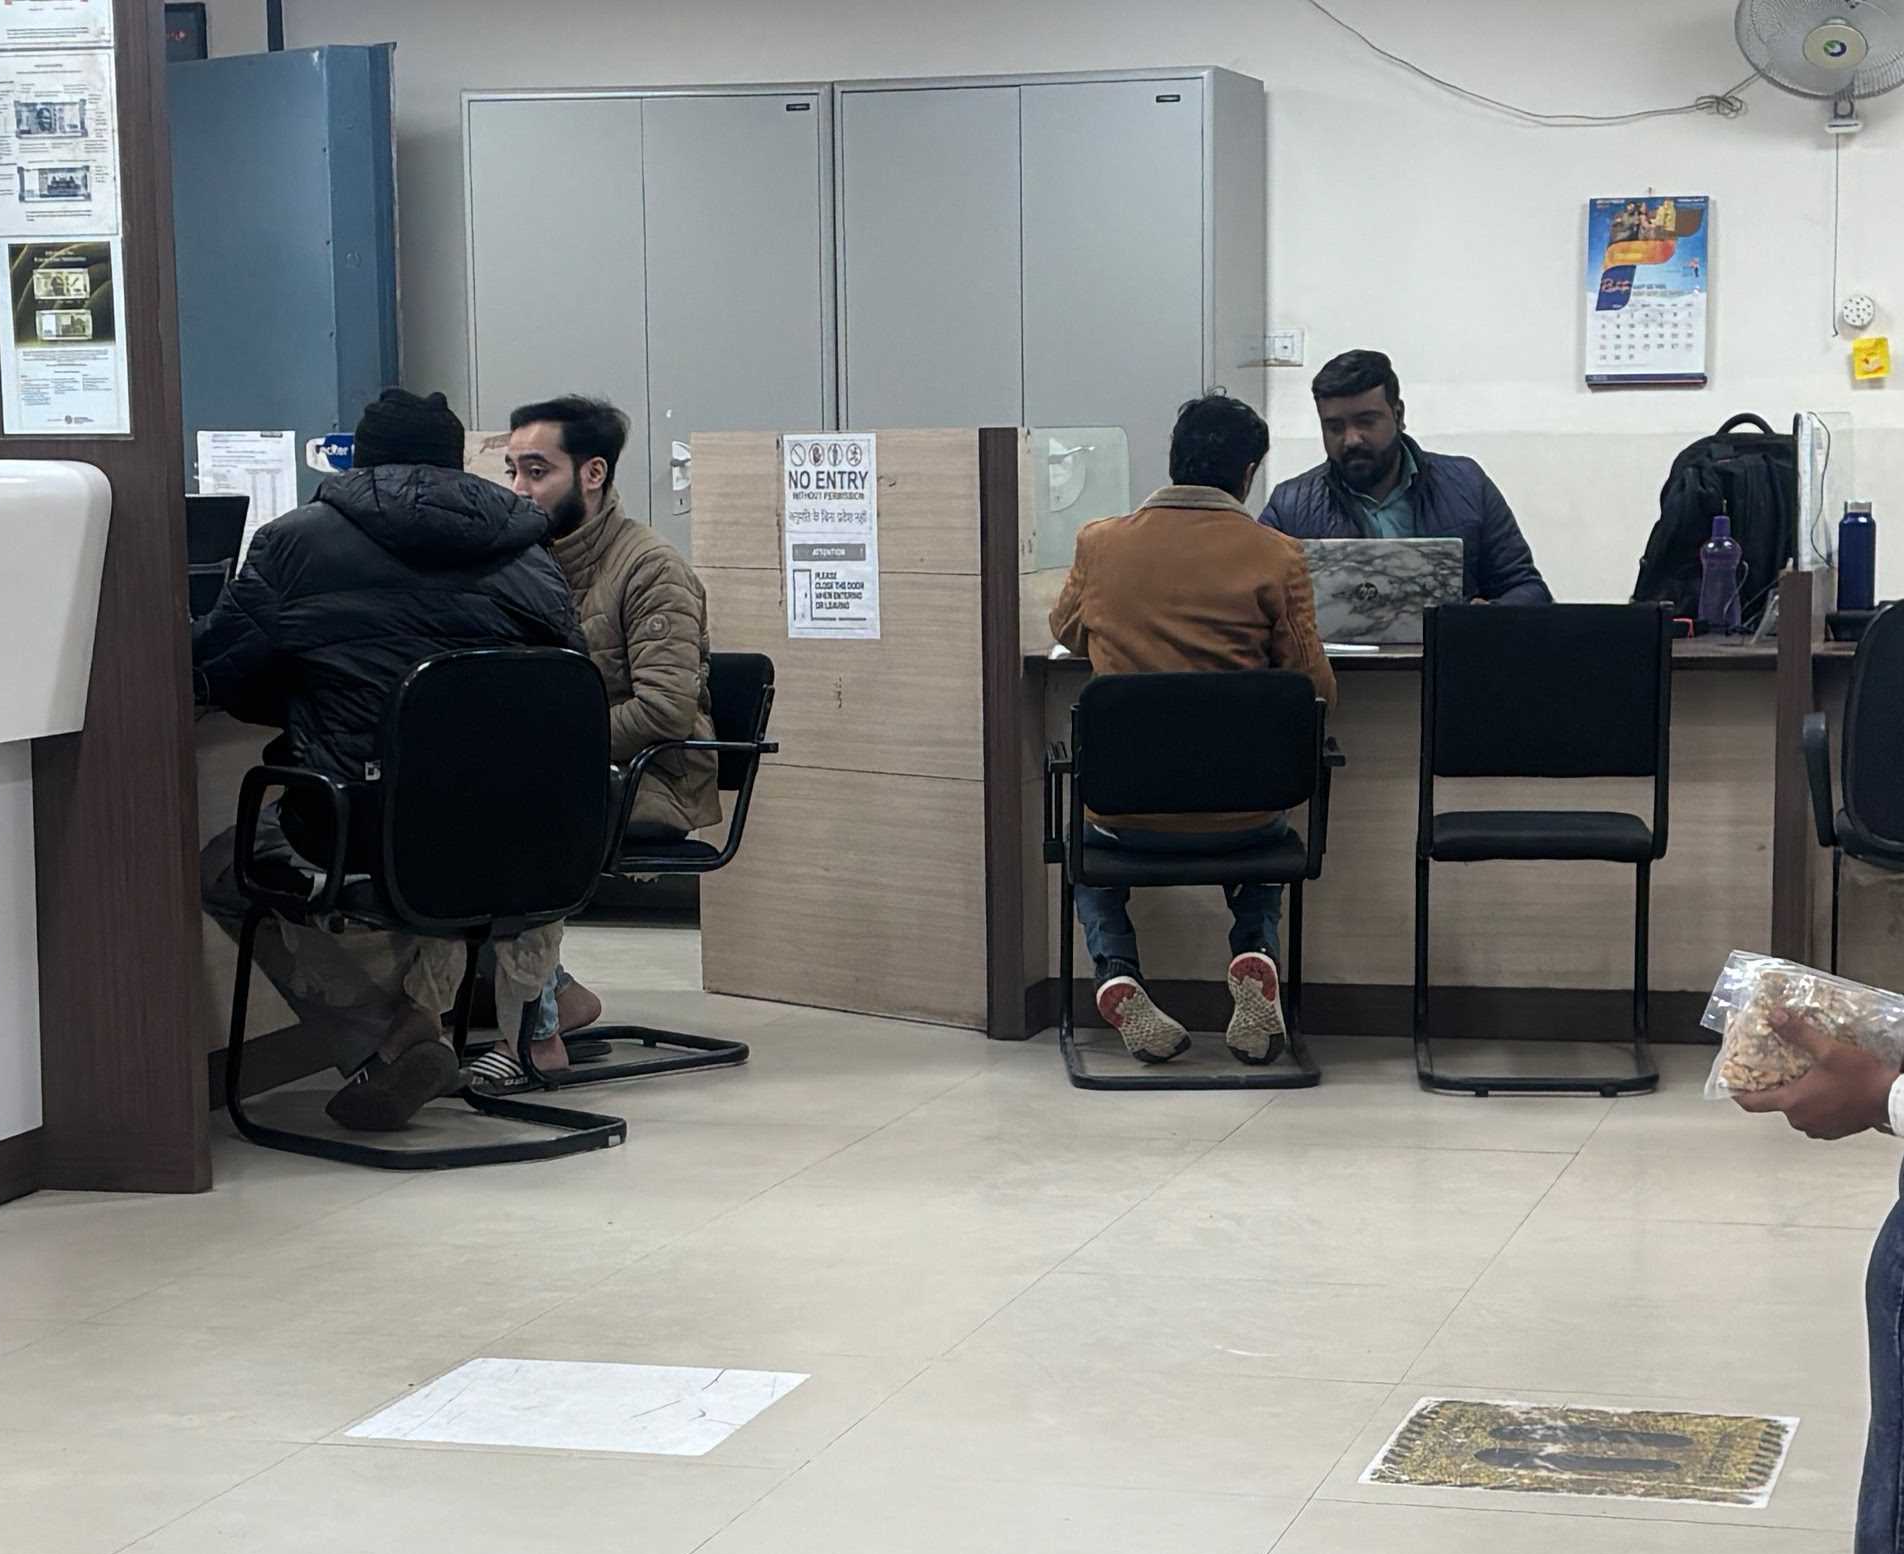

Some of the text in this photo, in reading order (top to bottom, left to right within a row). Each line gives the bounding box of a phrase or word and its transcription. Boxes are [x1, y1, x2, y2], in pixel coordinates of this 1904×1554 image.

[788, 470, 869, 490] NO ENTRY
[792, 491, 865, 501] WITHOUT PERMISSION
[847, 581, 865, 590] DOOR
[815, 601, 824, 610] OR
